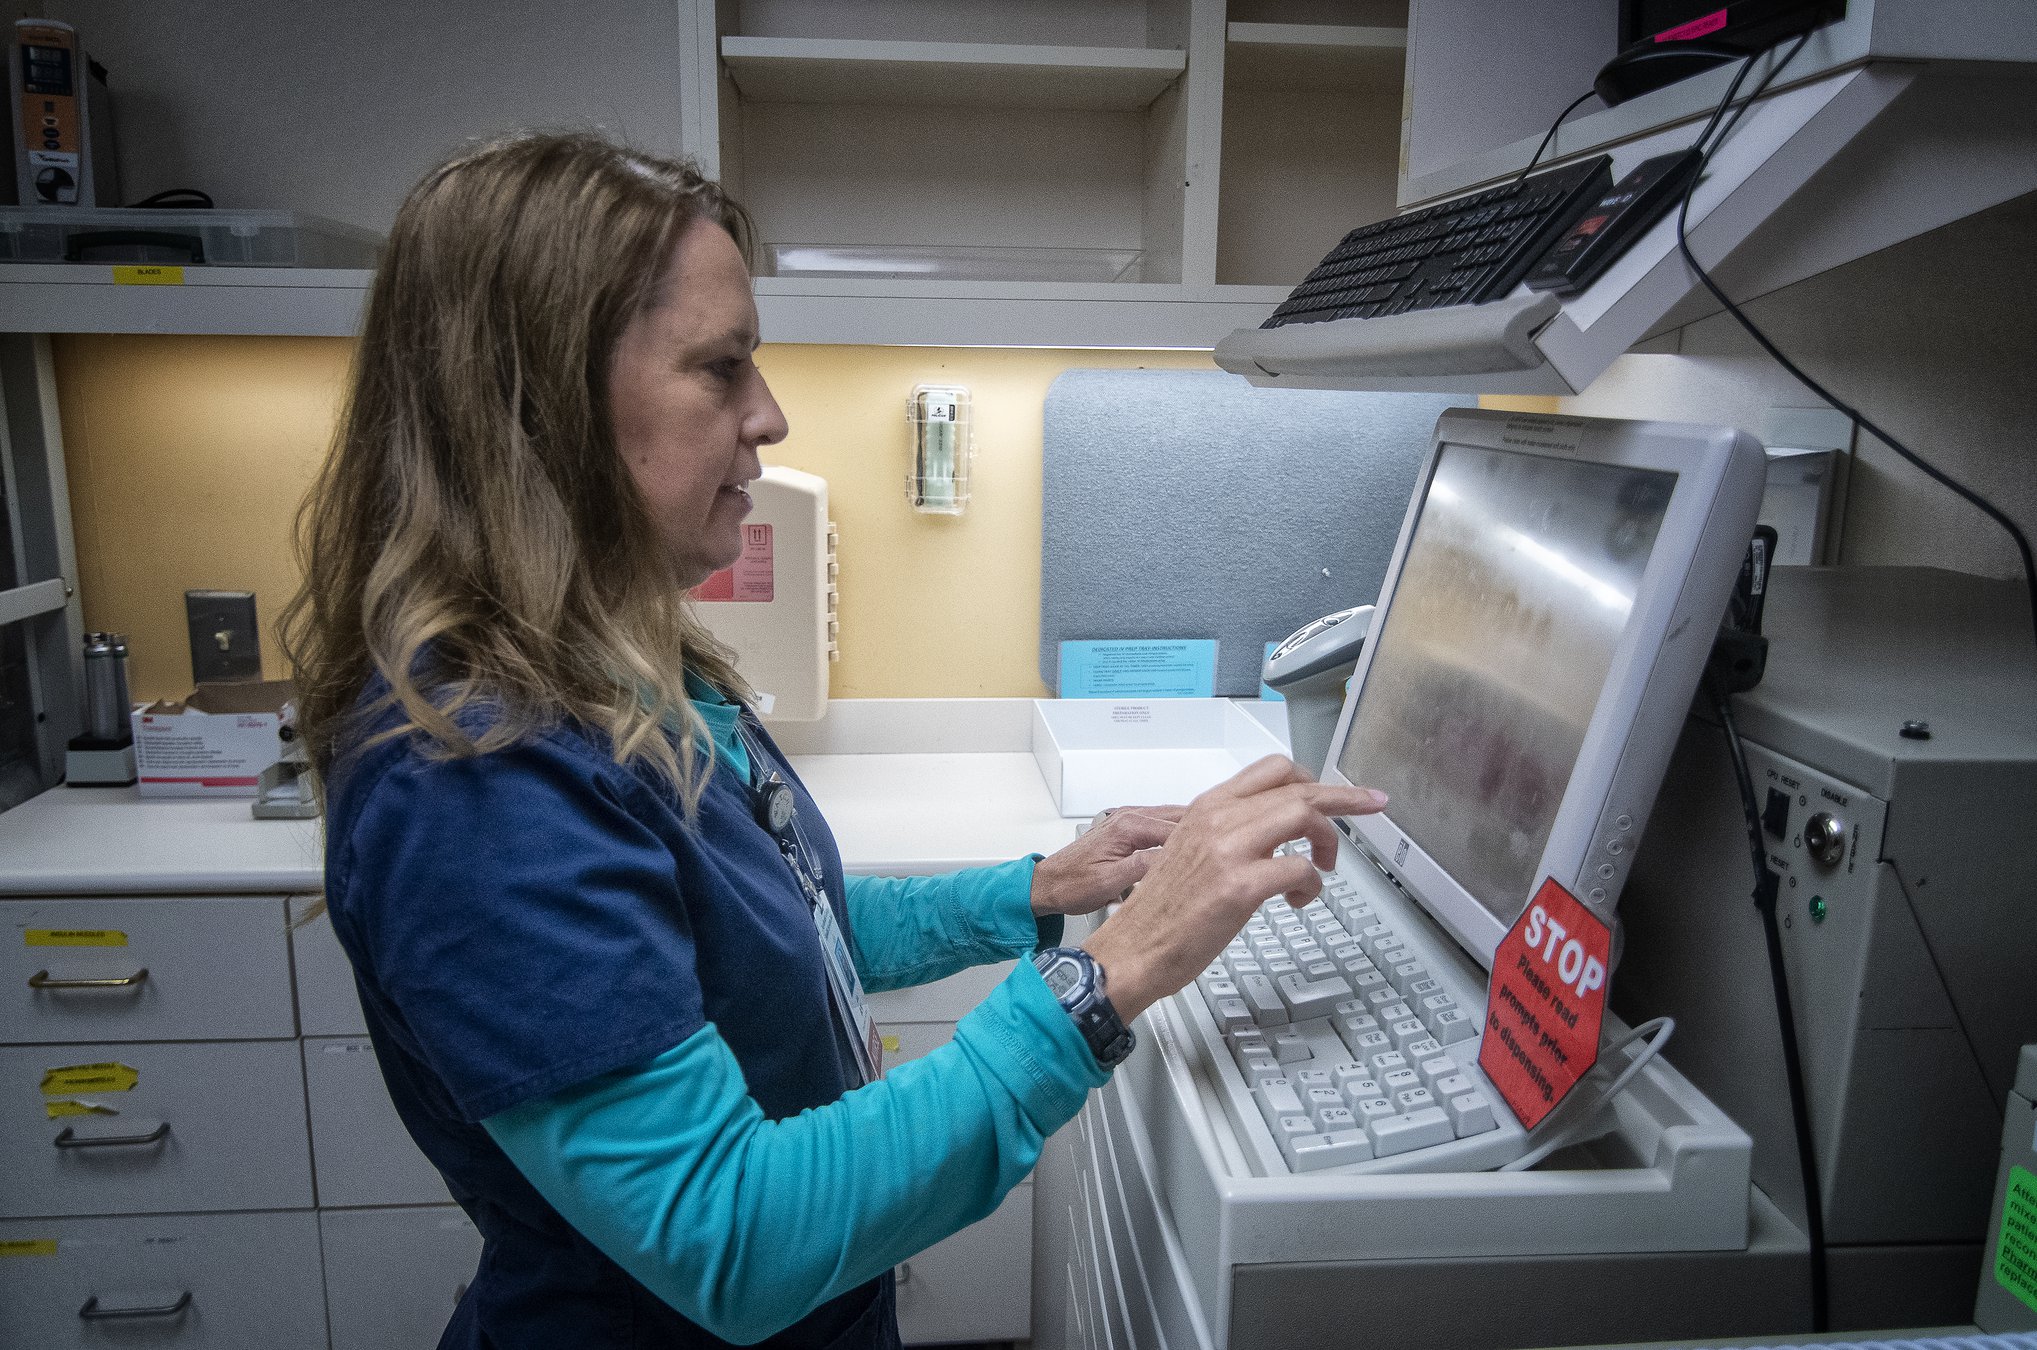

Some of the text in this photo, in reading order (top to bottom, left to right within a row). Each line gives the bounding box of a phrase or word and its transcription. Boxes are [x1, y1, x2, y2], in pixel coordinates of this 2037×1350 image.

[1781, 775, 1800, 790] RESET
[1820, 788, 1848, 807] DISABLE
[1770, 855, 1789, 870] RESET
[1524, 904, 1605, 999] STOP
[1516, 953, 1579, 1030] Please read
[1499, 983, 1568, 1066] prompts prior
[1488, 1010, 1500, 1032] to
[1500, 1026, 1554, 1102] dispensing.
[2012, 1183, 2037, 1208] Atte
